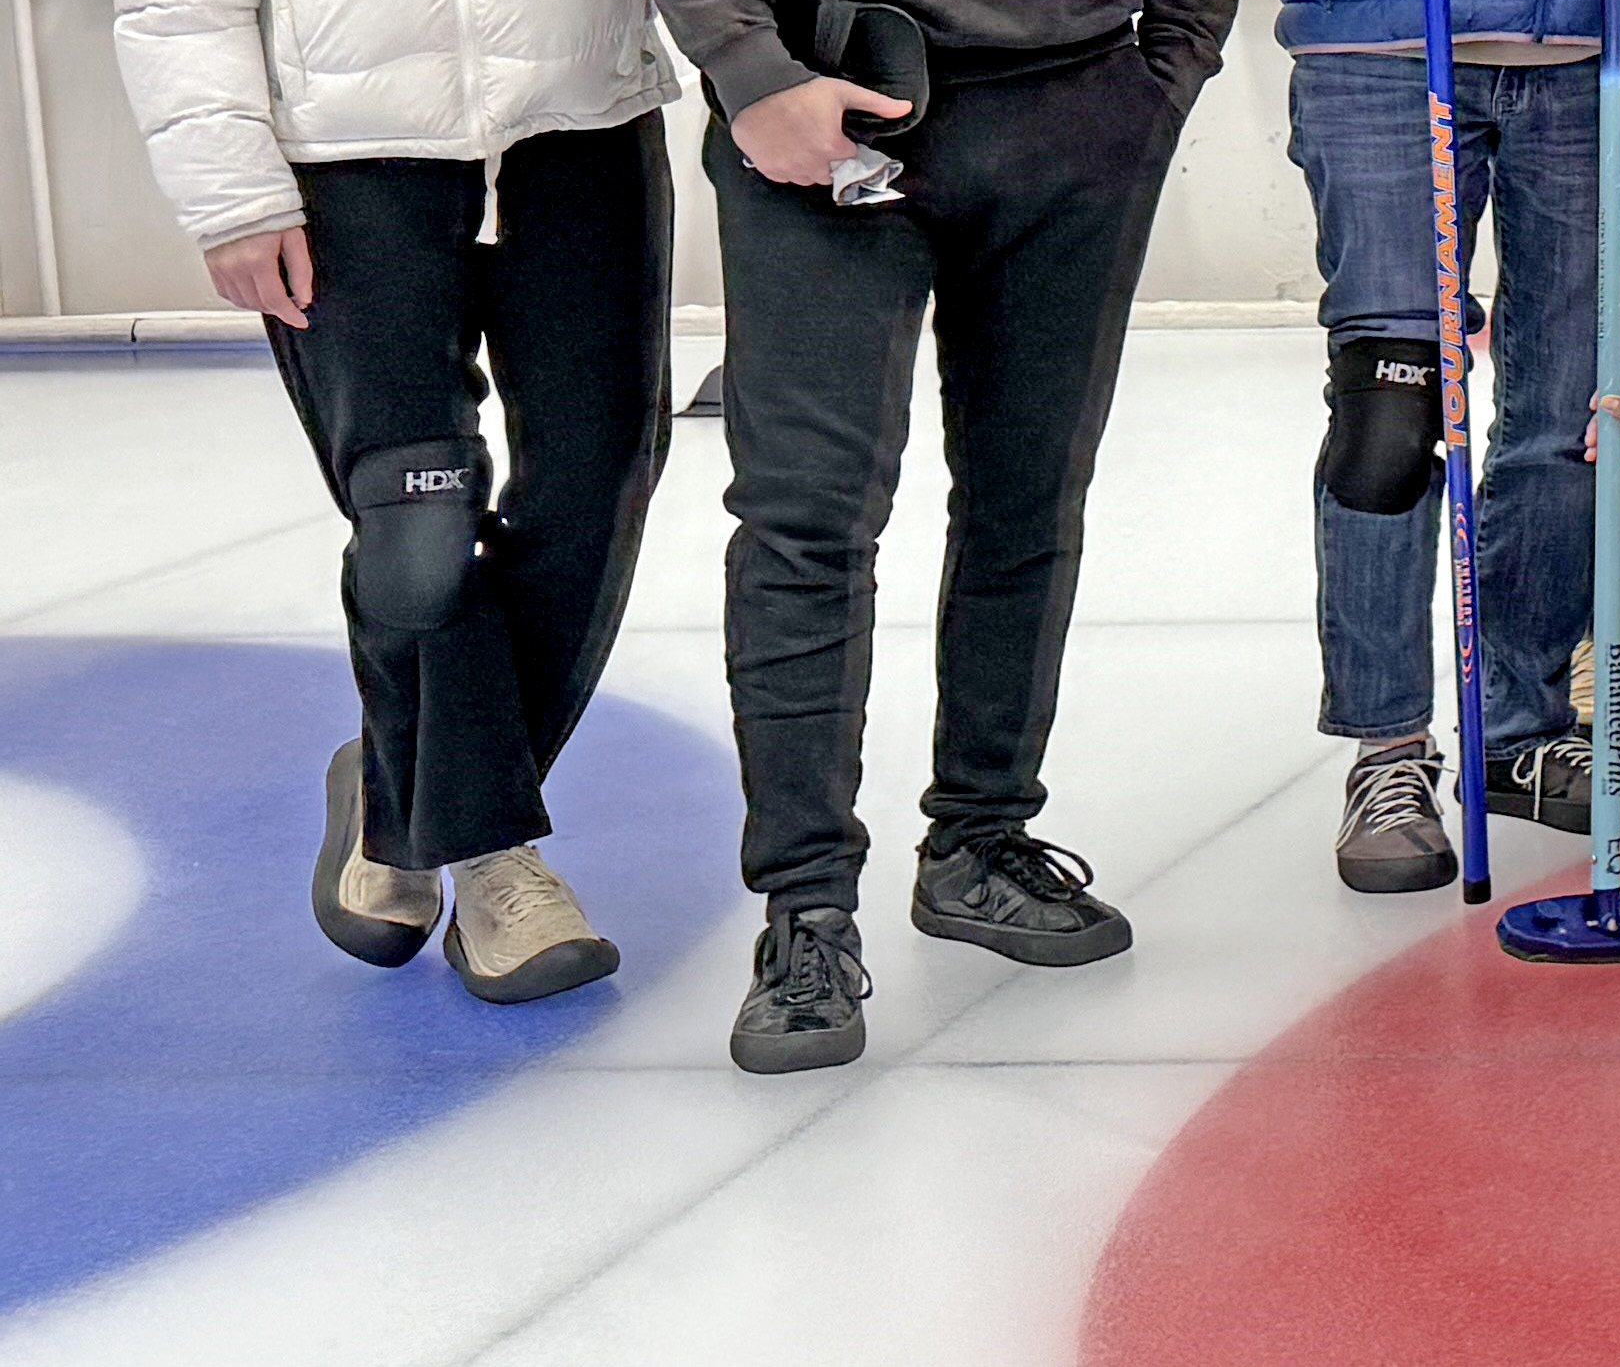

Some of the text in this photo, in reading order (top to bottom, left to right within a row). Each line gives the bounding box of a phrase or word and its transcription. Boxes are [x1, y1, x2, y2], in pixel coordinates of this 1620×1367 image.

[1429, 92, 1467, 450] TOURNAMENT
[1375, 359, 1428, 386] HDX
[405, 468, 465, 493] HDX
